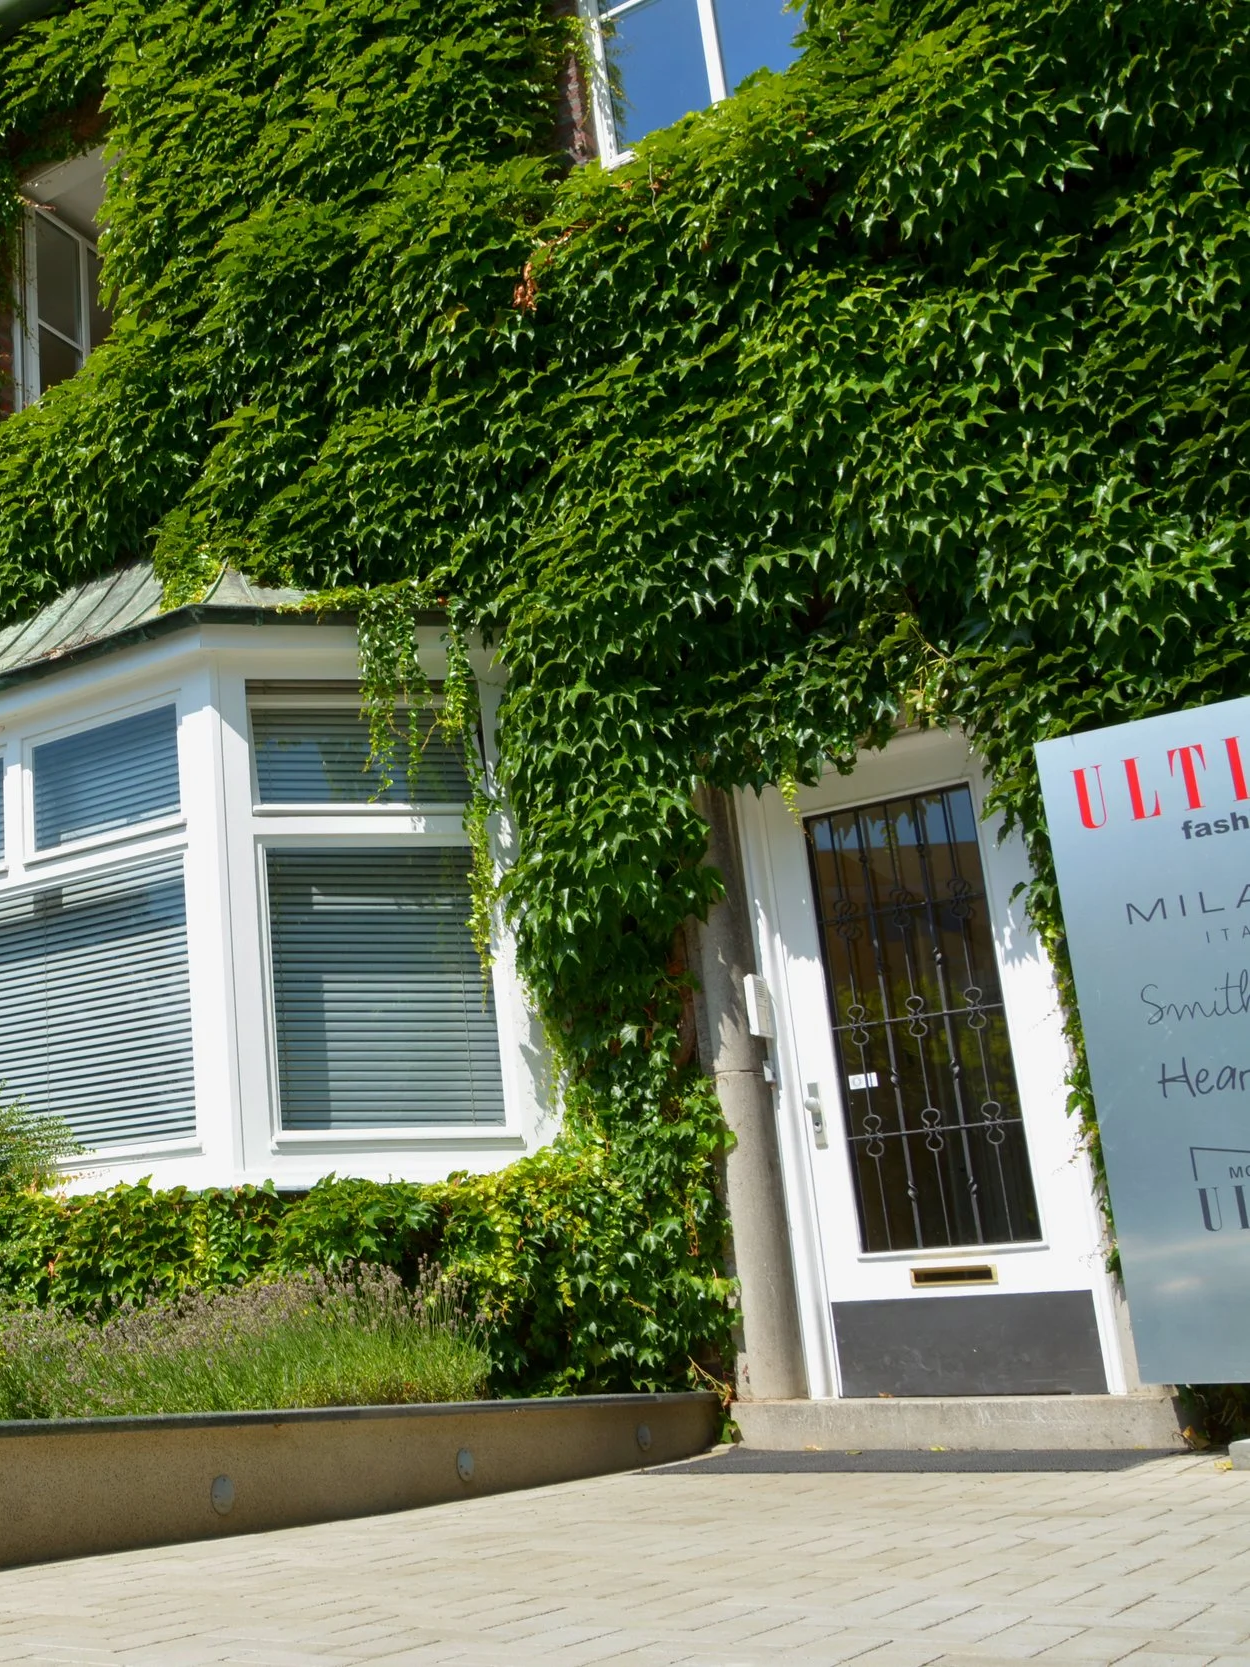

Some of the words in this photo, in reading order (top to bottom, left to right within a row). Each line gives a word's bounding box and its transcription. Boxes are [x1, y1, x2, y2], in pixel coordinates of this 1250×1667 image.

[1070, 736, 1250, 829] ULTI
[1181, 811, 1250, 840] fash
[1157, 1056, 1250, 1098] Hear
